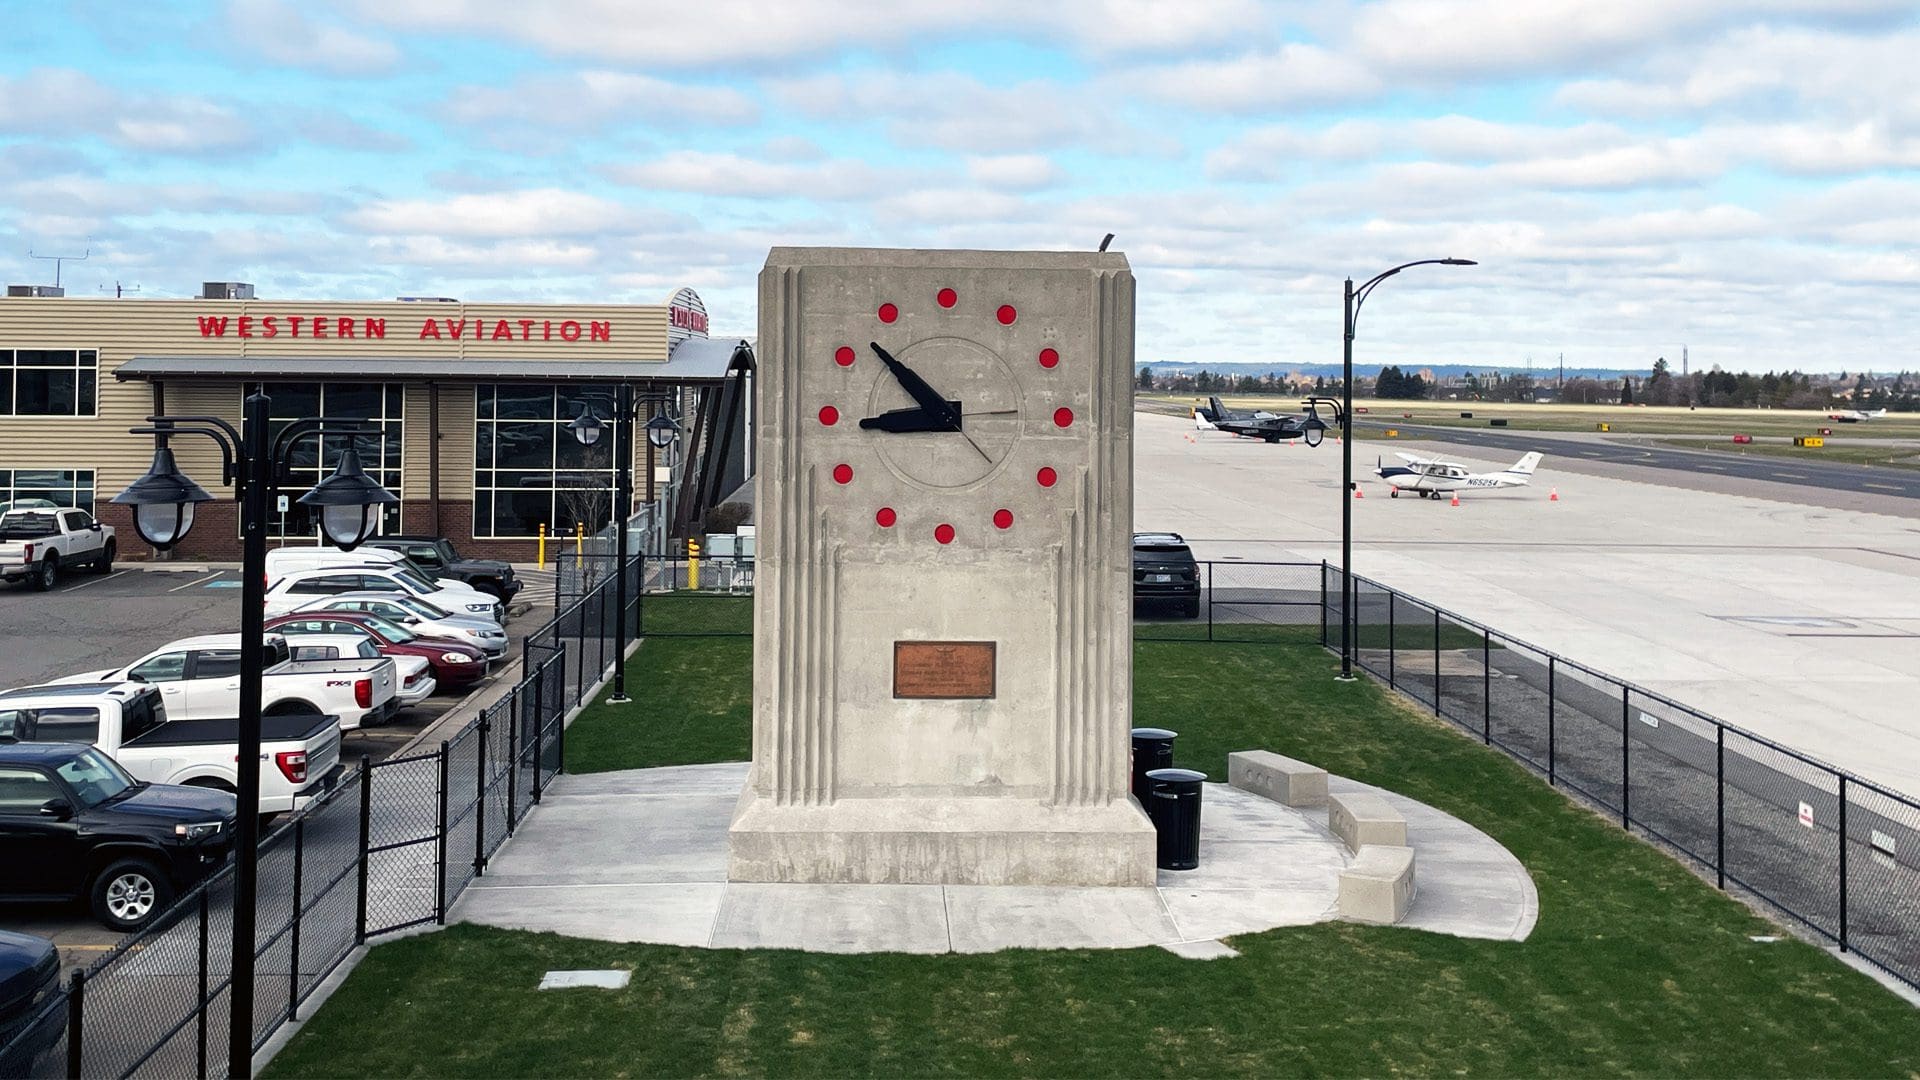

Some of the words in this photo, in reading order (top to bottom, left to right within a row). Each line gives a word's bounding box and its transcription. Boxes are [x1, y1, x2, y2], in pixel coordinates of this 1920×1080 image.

[198, 316, 386, 339] WESTERN
[419, 318, 611, 343] AVIATION
[1467, 478, 1499, 487] N65254
